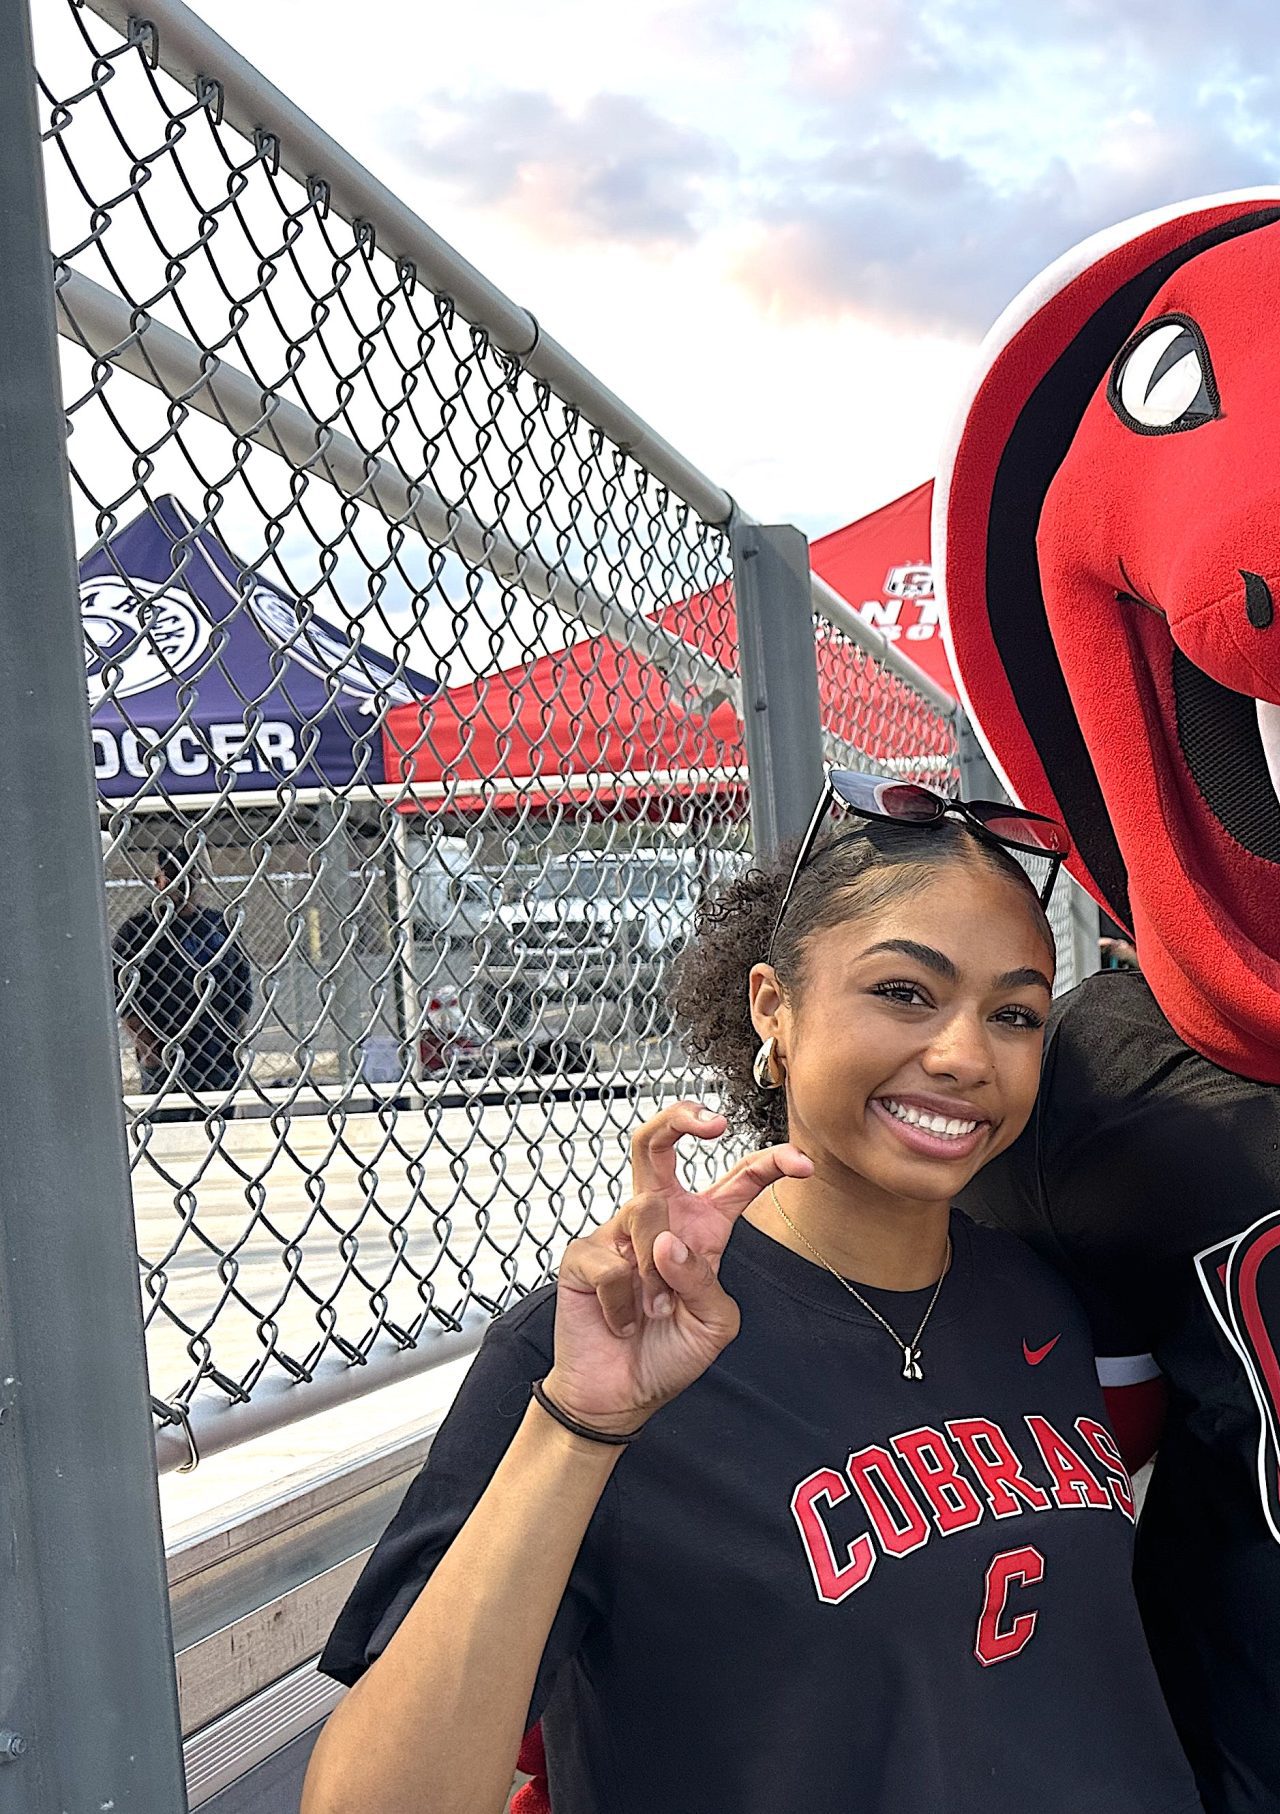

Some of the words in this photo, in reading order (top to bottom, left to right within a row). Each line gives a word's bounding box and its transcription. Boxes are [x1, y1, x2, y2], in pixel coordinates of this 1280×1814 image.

[92, 721, 298, 780] OCCER
[790, 1415, 1137, 1605] COBRAS
[974, 1544, 1045, 1668] C
